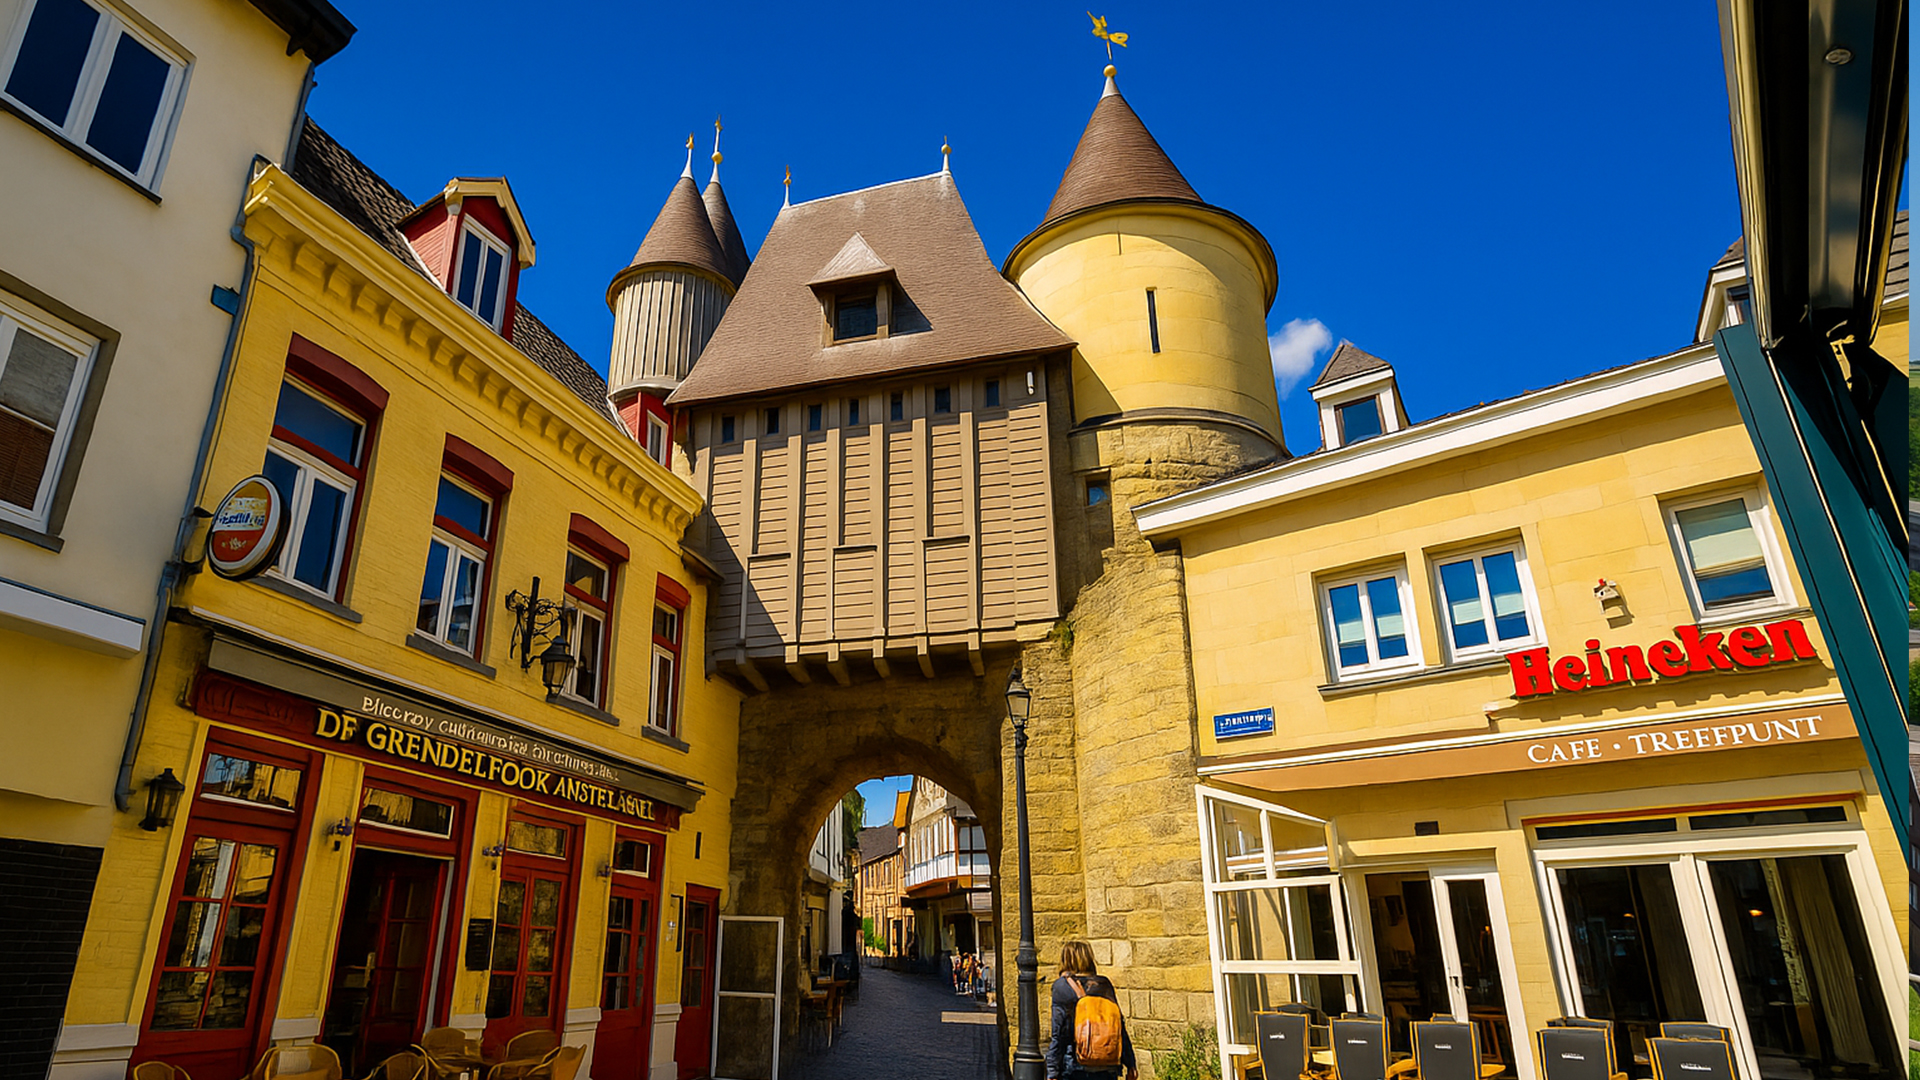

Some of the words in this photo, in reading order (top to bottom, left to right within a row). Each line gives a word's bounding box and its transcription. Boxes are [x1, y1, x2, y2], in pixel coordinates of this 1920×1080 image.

[1505, 619, 1817, 697] Heineken
[366, 722, 551, 795] GRENDELFOOK
[1527, 738, 1602, 764] CAFE
